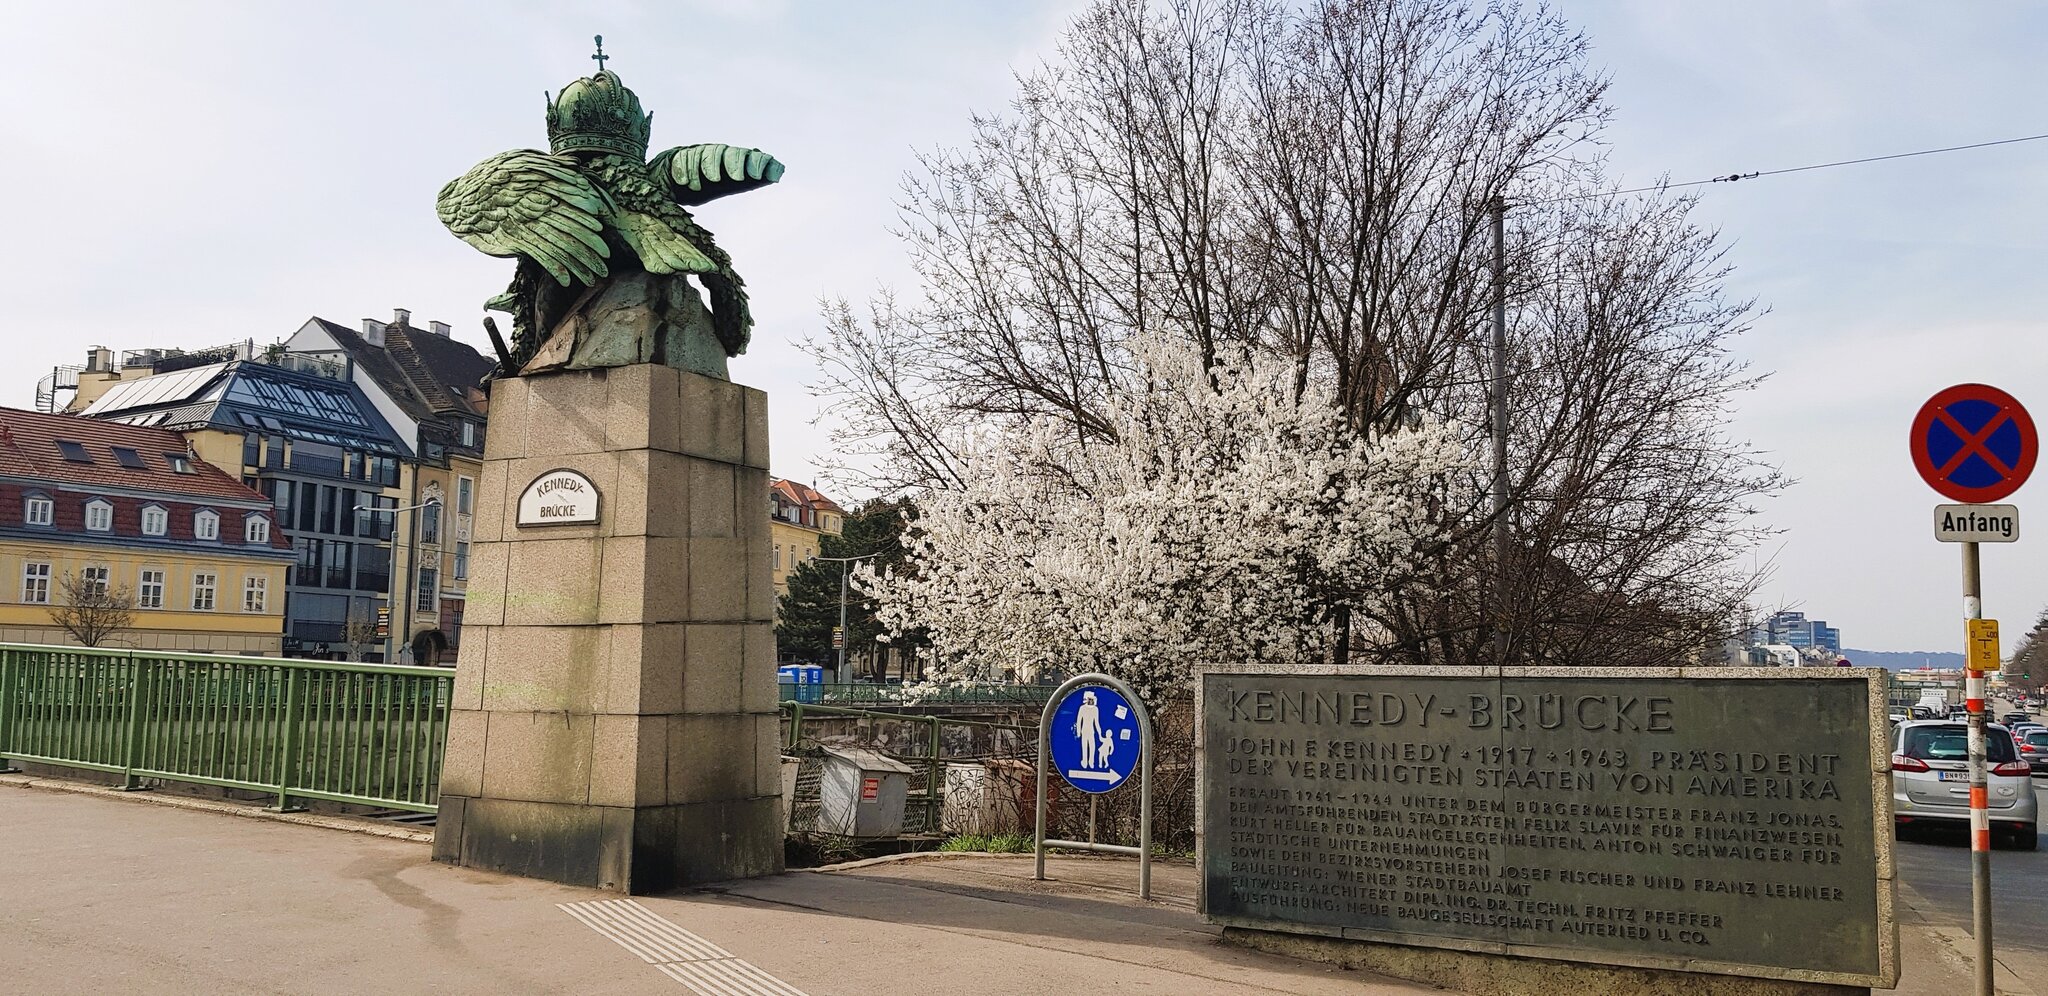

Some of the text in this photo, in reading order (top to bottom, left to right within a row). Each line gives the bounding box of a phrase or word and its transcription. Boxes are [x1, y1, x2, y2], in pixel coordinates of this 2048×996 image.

[537, 478, 584, 498] KENNEDY-
[540, 503, 576, 517] BRÜCKE
[1943, 512, 2011, 537] Anfang
[1227, 690, 1672, 731] KENNEDY-BRÜCKE
[1226, 737, 1295, 756] JOHN
[1327, 740, 1450, 763] KENNEDY
[1476, 746, 1534, 765] 1917
[1565, 748, 1628, 767] 1963
[1651, 750, 1840, 775] PRÄSIDENT
[1229, 758, 1839, 800] DER VEREINIGTEN STAATEN VON AMERIKA
[1229, 787, 1289, 799] ERBAUT
[1402, 795, 1458, 809] UNTER
[1467, 800, 1505, 813] DEM
[1516, 801, 1681, 821] BÜRGERMEISTER
[1690, 808, 1758, 824] FRANZ
[1230, 802, 1257, 814] DEN
[1264, 804, 1401, 822] AMTSFÜHRENDEN
[1408, 811, 1515, 829] STADTRÄTEN
[1524, 818, 1570, 832] FELIX
[1579, 821, 1642, 836] SLAVIK
[1651, 824, 1684, 838] FÜR
[1230, 816, 1266, 828] KURT
[1274, 818, 1329, 833] HELLER
[1336, 823, 1365, 835] FÜR
[1593, 839, 1662, 854] ANTON
[1671, 842, 1793, 862] SCHWAIGER
[1801, 848, 1841, 864] FÜR
[1230, 831, 1489, 860] STÄDTISCHE UNTERNEHMUNGEN
[1230, 846, 1843, 901] SOWIE DEN BEZIRKSVORSTEHERN JOSEF FISCHER UND FRANZ LEHNER
[1231, 861, 1531, 897] BAULEITUNG: WIENER STADTBAUAMT
[1308, 882, 1397, 901] ARCHITEKT
[1585, 904, 1635, 921] FRITZ
[1643, 910, 1722, 928] PFEFFER
[1347, 902, 1389, 917] NEUE
[1398, 906, 1554, 933] BAUGESELLSCHAFT
[1560, 920, 1649, 940] AUTERIED
[1657, 928, 1673, 941] U.
[1679, 930, 1710, 945] CO.
